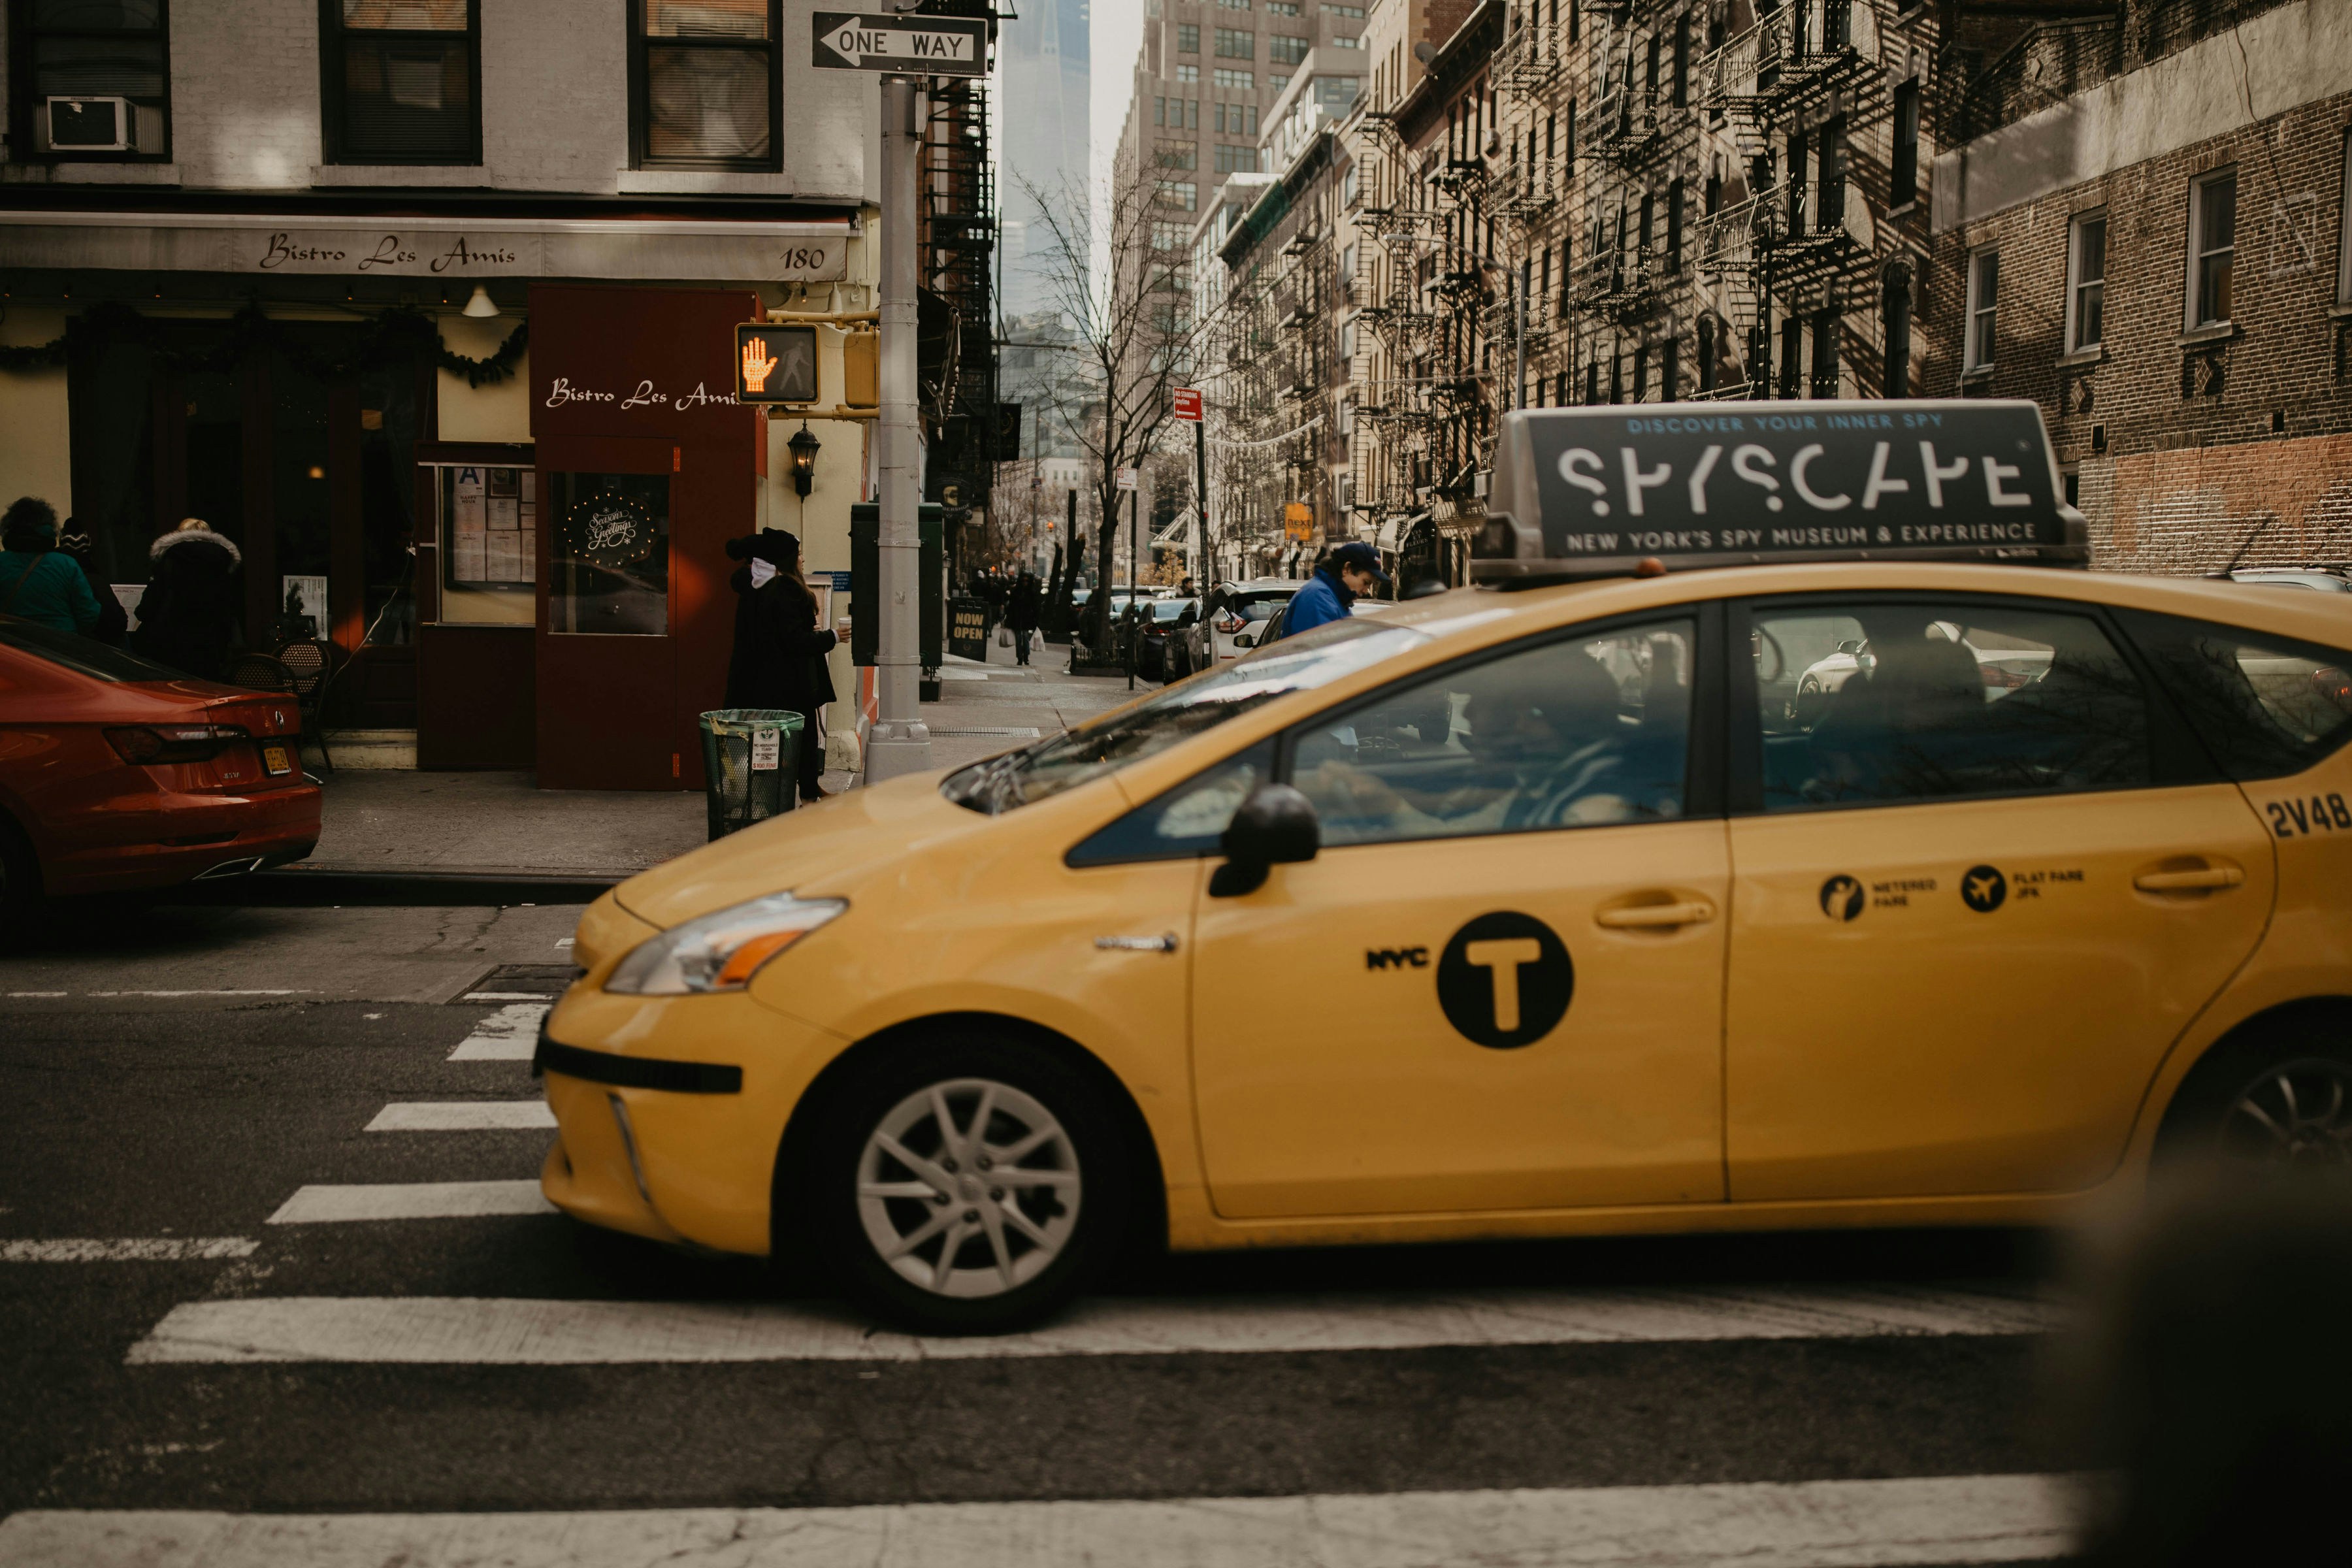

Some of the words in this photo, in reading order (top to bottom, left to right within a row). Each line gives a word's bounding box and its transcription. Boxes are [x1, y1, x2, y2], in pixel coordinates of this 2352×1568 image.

[839, 30, 887, 54] ONE
[912, 34, 963, 57] WAY
[259, 233, 346, 269] Bistro
[358, 235, 416, 270] Les
[431, 237, 515, 272] Amis
[779, 248, 825, 270] 180
[546, 378, 615, 409] Bistro
[621, 380, 667, 411] Les
[675, 381, 740, 411] Ami
[1627, 416, 1744, 434] DISCOVER
[1754, 416, 1817, 431] YOUR
[1827, 414, 1894, 429] INNER
[1903, 413, 1943, 428] SPY
[459, 468, 480, 484] A
[1558, 440, 2031, 517] SPYSCAPE
[589, 508, 629, 529] Season's
[1288, 518, 1311, 528] next
[585, 520, 637, 550] Greetings
[1568, 533, 1619, 551] NEW
[1629, 530, 1712, 549] YORK'S
[1721, 528, 1763, 547] SPY
[1772, 525, 1867, 546] MUSEUM
[1876, 525, 1892, 542] &
[1901, 522, 2036, 542] EXPERIENCE
[956, 612, 983, 625] NOW
[954, 626, 983, 640] OPEN
[2013, 871, 2046, 884] FLAT
[2050, 870, 2085, 883] FARE
[1873, 896, 1908, 907] FARE
[1366, 948, 1429, 970] NYC
[1465, 938, 1542, 1032] T
